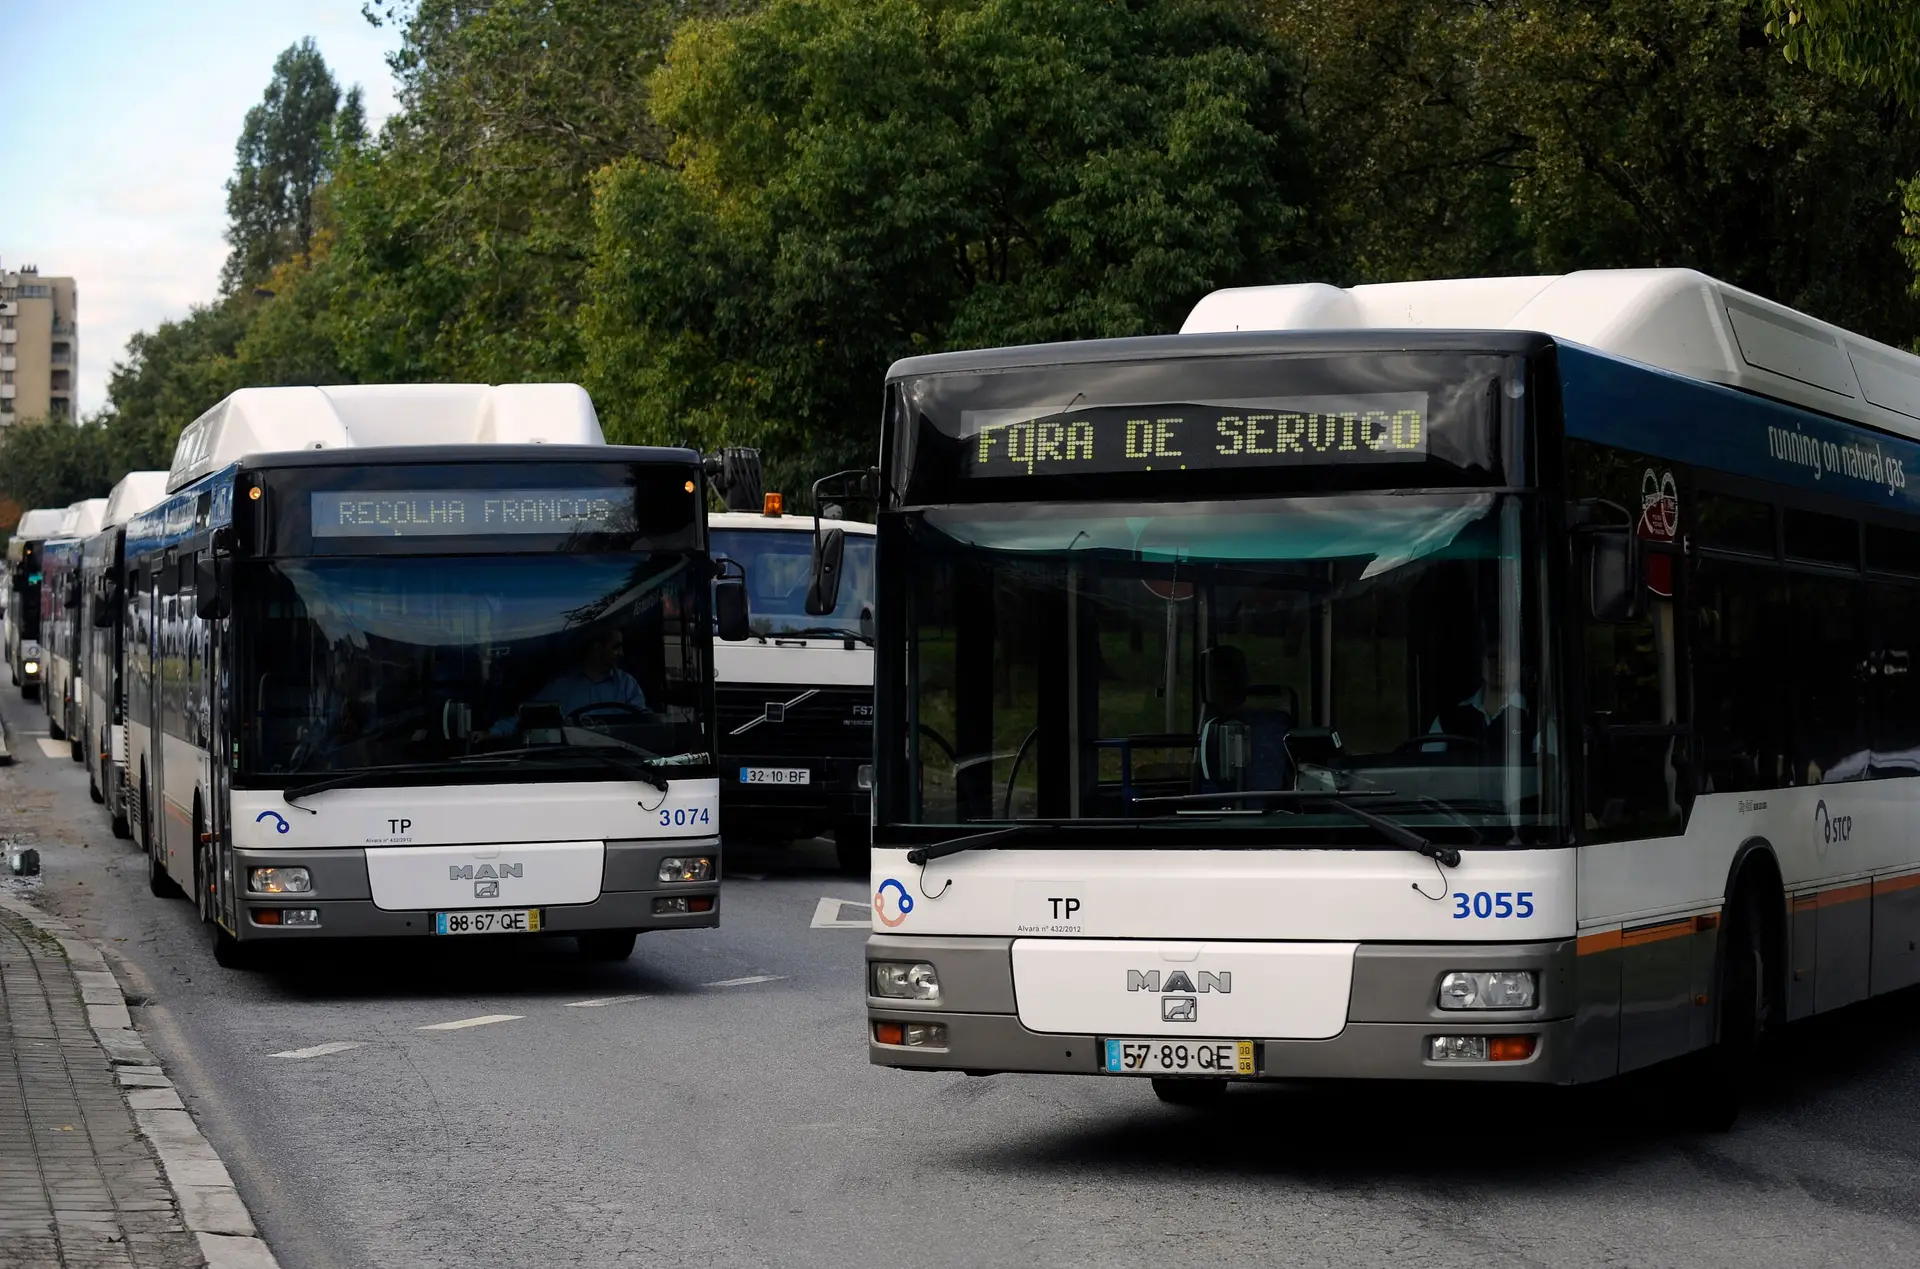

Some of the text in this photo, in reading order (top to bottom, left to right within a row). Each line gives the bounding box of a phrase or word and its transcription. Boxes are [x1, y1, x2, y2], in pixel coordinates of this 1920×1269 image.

[978, 419, 1095, 464] FORA
[1125, 418, 1183, 459] DE
[1768, 422, 1906, 496] running on natural gas
[339, 498, 609, 524] RECOLHA FRANCOS
[388, 819, 412, 834] TP
[659, 808, 710, 826] 3074
[1832, 815, 1852, 842] STCP
[449, 863, 523, 880] MAN
[1047, 897, 1081, 920] TP
[1452, 891, 1535, 919] 3055
[1050, 925, 1081, 933] 432/2012
[1127, 969, 1231, 994] MAN
